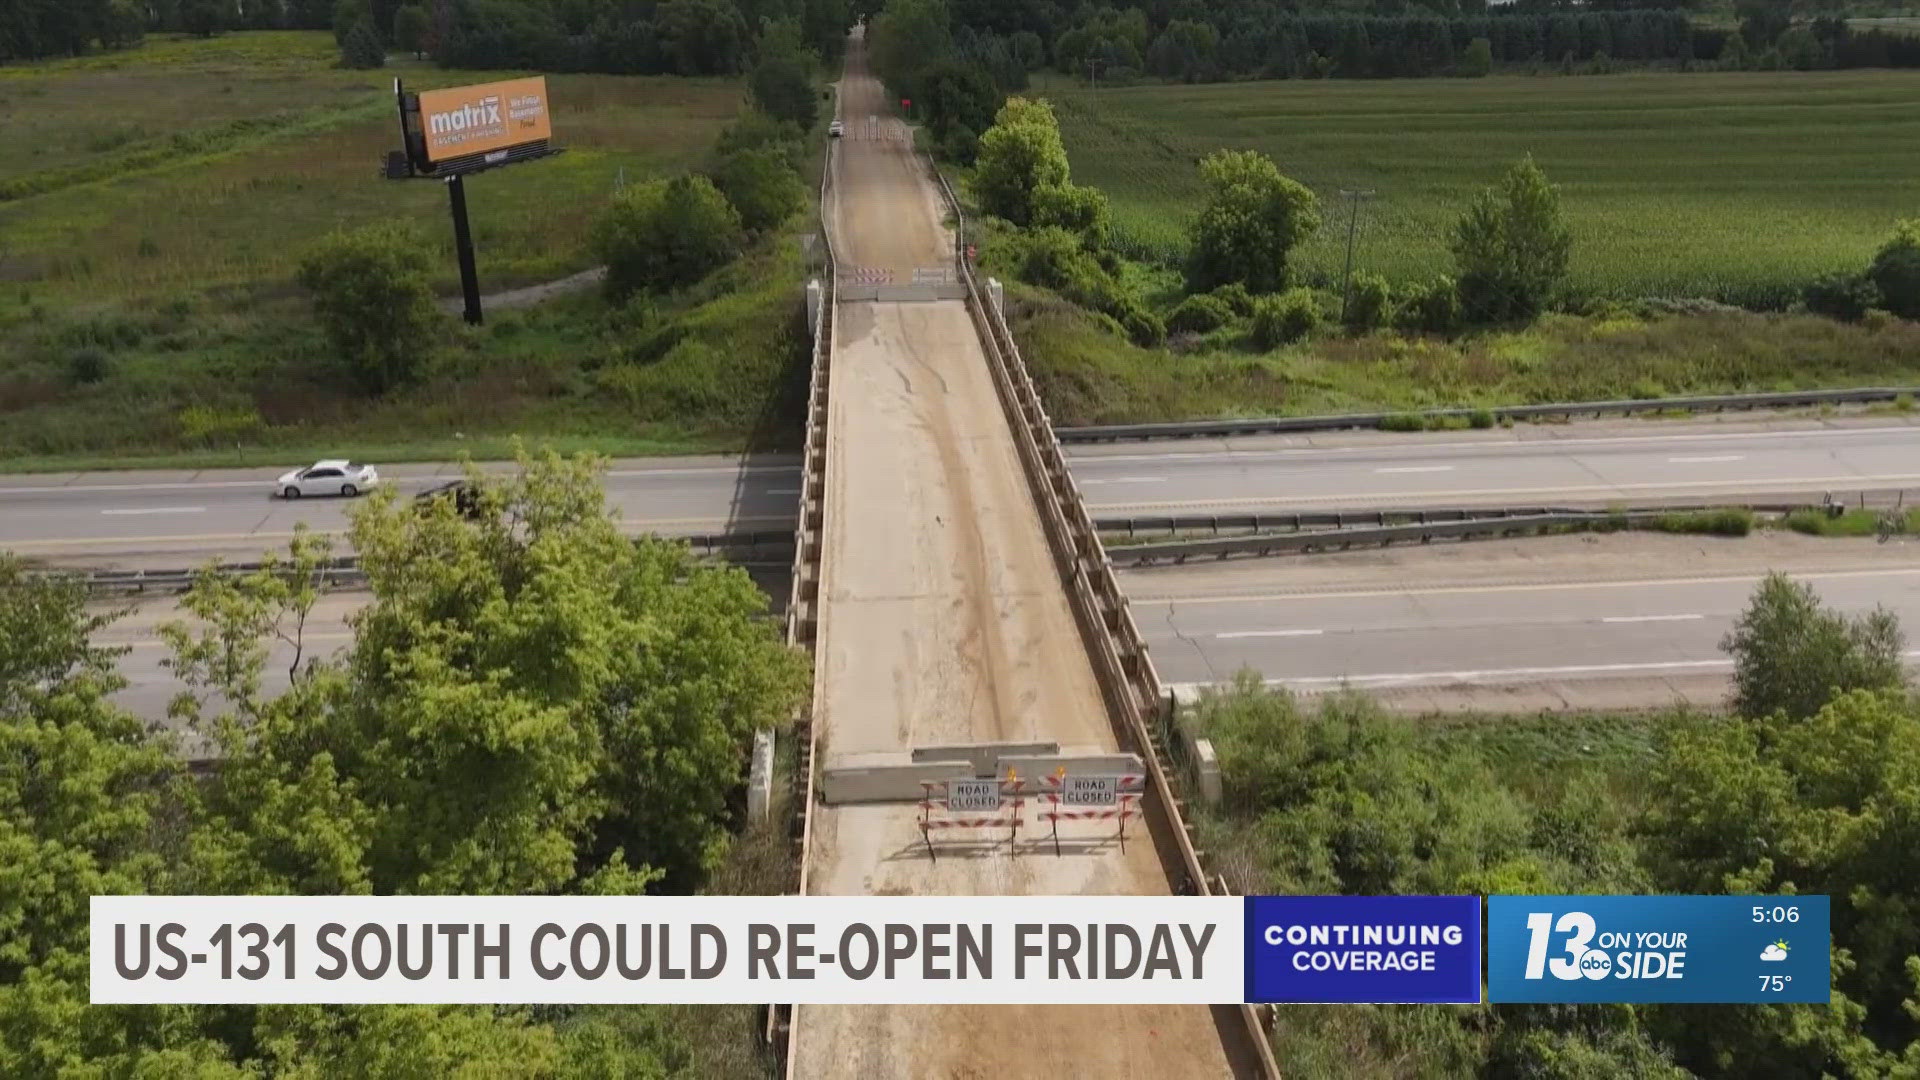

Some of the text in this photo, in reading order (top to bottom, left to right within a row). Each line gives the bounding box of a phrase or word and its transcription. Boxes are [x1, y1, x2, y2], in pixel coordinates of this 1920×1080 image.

[430, 96, 501, 134] matrix
[957, 785, 989, 795] ROAD
[1074, 780, 1106, 790] ROAD
[951, 796, 996, 807] CLOSED
[1067, 791, 1111, 802] CLOSED
